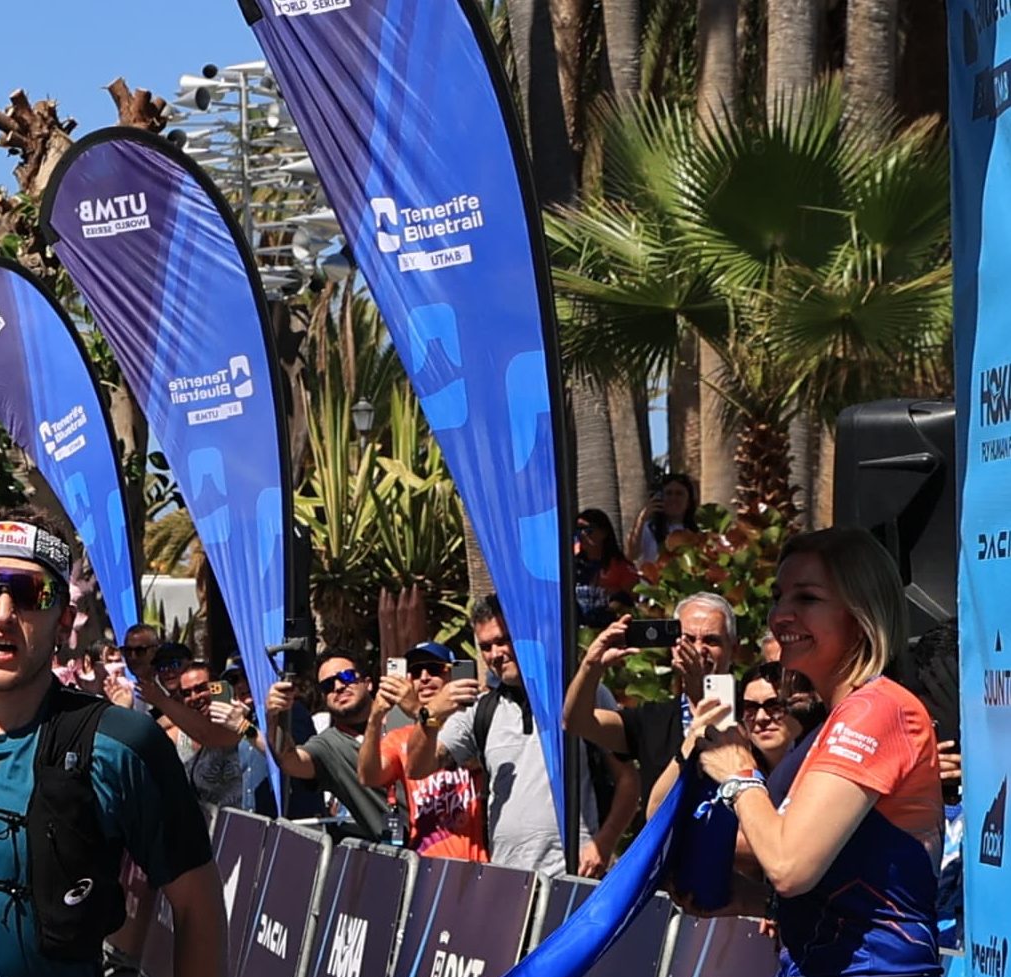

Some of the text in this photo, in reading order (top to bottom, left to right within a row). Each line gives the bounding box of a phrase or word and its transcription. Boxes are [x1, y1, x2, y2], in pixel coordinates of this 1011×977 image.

[400, 194, 481, 226] Tenerife
[403, 210, 484, 243] Bluetrail
[430, 250, 462, 266] UTMB
[6, 533, 27, 545] Bull
[978, 530, 1011, 560] DACI
[984, 670, 1011, 707] SUUNT
[257, 913, 288, 960] DACIA
